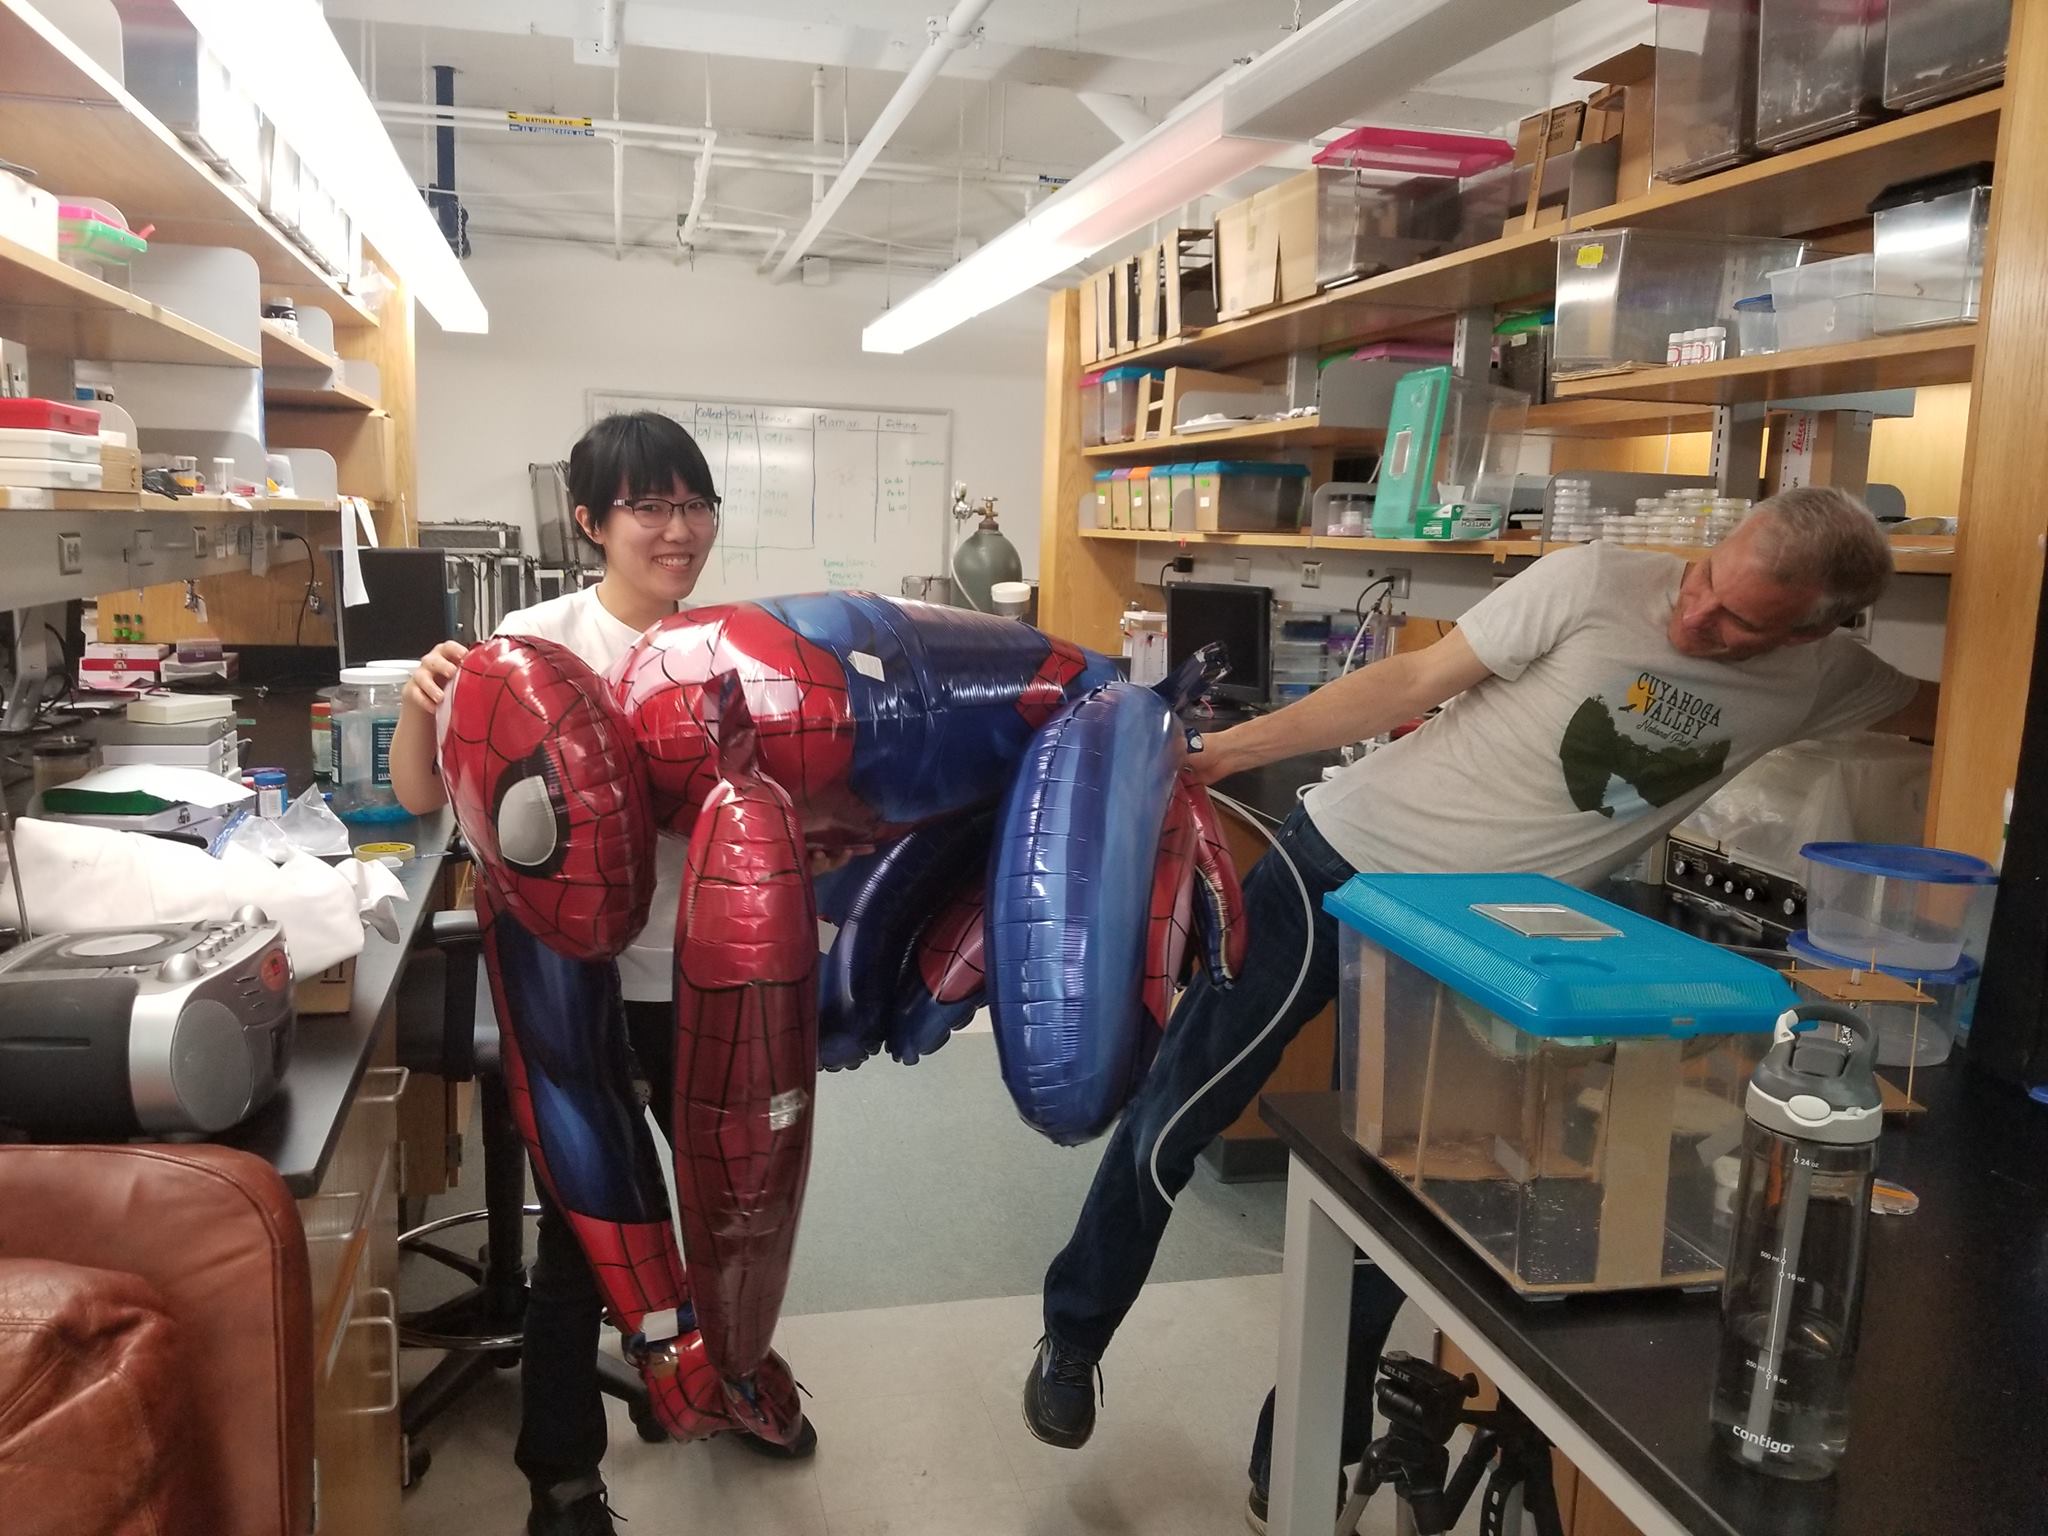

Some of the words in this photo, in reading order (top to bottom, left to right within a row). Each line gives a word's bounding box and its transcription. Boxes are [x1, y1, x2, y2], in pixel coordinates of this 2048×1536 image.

[1638, 672, 1722, 727] CUYAHOGA
[1643, 696, 1707, 739] VALLEY
[1800, 1158, 1810, 1166] 24
[1760, 1250, 1771, 1260] 500
[1787, 1272, 1796, 1281] 16
[1746, 1359, 1757, 1369] 250
[1732, 1425, 1795, 1454] contigo
